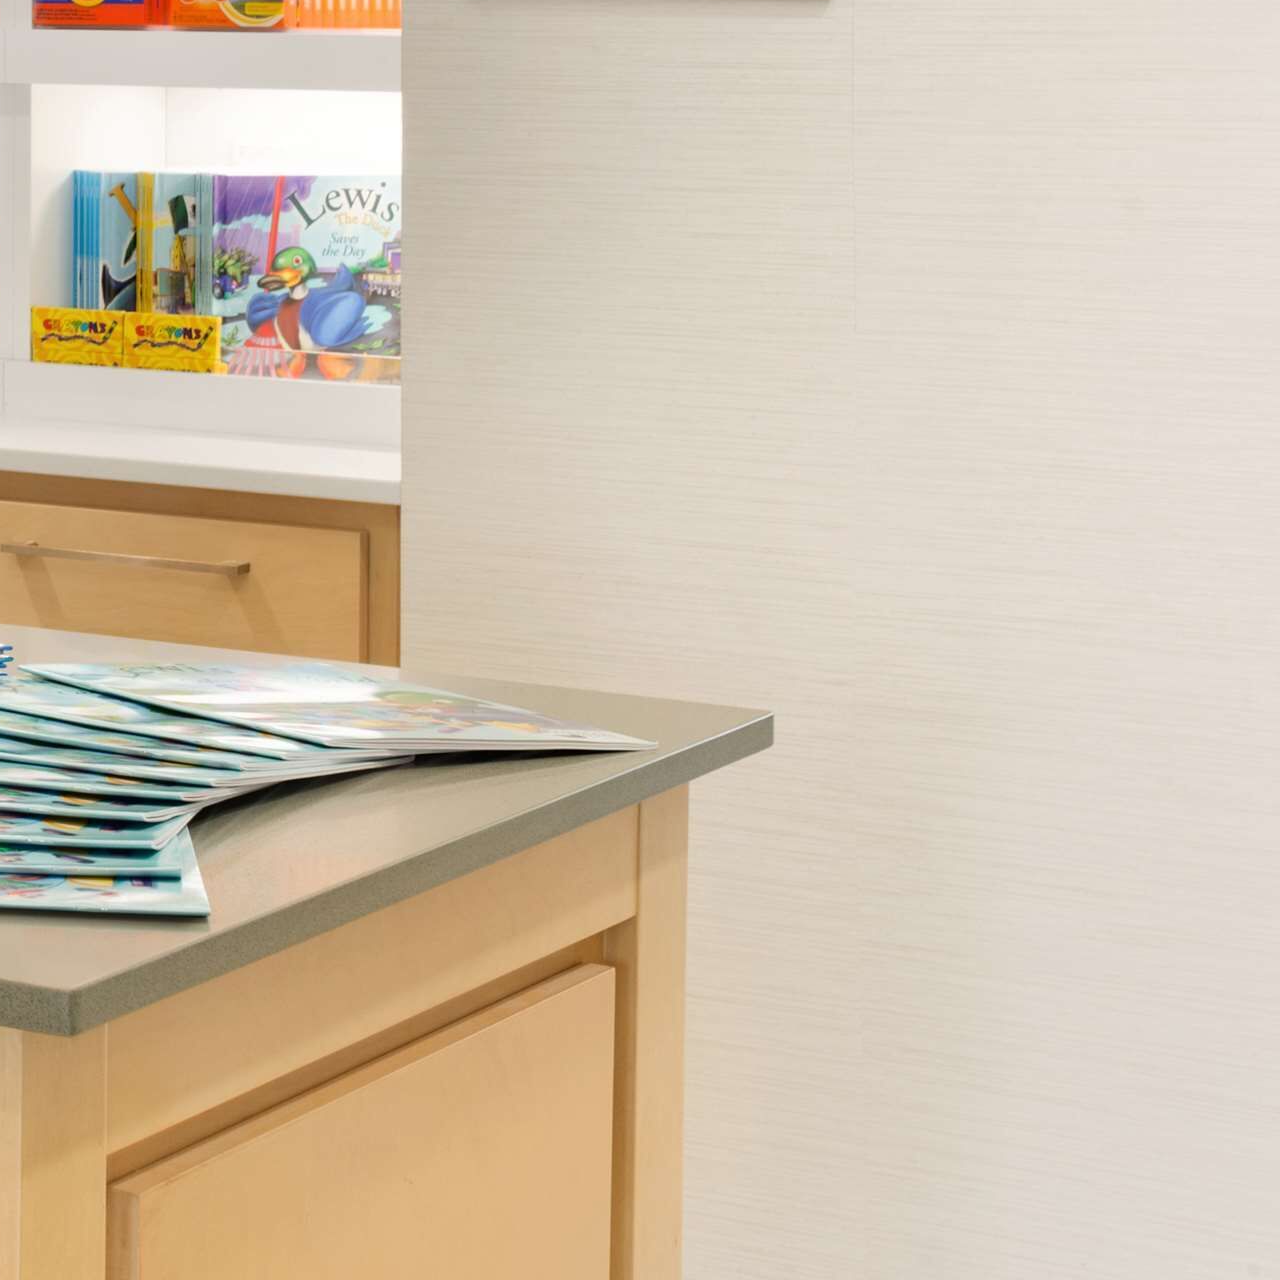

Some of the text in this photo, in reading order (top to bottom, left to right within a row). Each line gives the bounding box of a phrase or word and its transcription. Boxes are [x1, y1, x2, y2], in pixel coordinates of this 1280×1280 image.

[285, 181, 401, 231] Lewis
[328, 230, 361, 246] Saves
[320, 243, 368, 260] the Day
[42, 318, 108, 334] CRAYONS
[135, 324, 202, 339] CRAYONS
